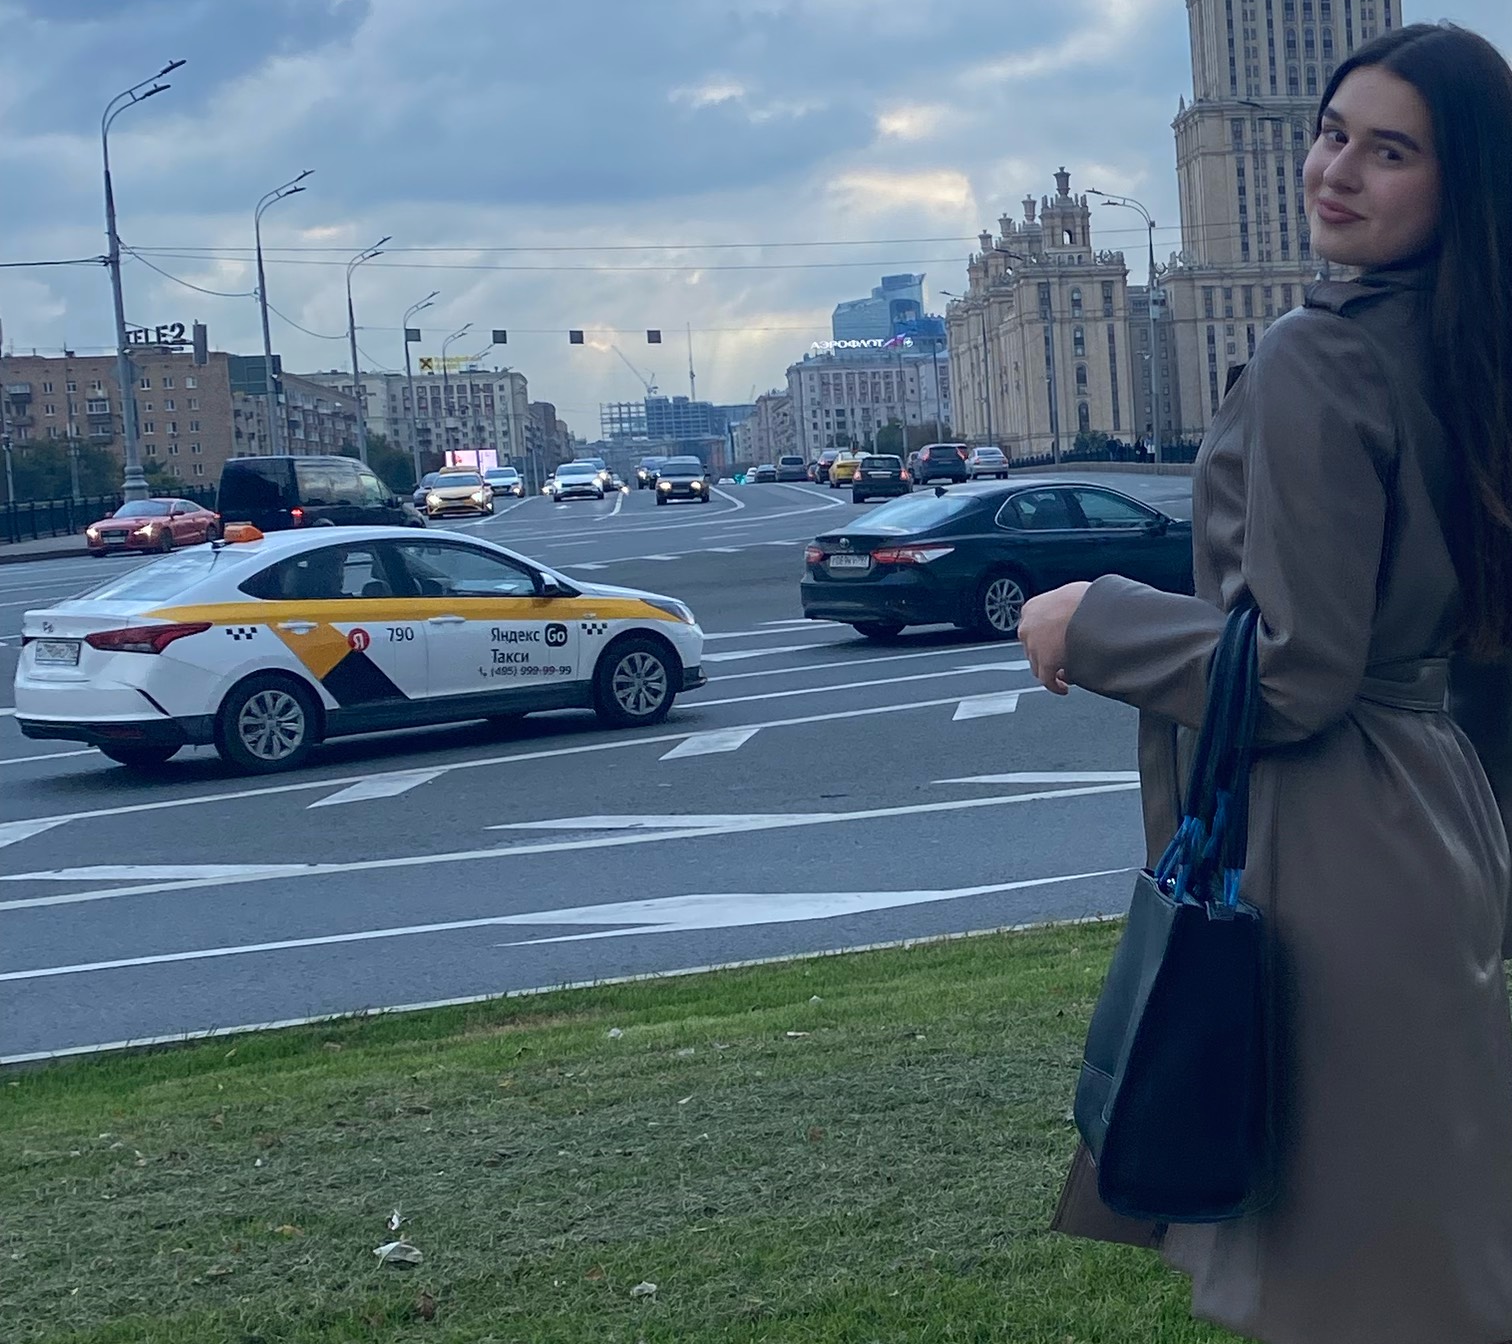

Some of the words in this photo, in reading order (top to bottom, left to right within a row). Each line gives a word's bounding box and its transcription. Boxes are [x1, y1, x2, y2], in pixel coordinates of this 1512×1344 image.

[124, 322, 185, 344] TELE2
[811, 339, 884, 349] АЭРОФЛОТ
[386, 627, 415, 642] 790
[491, 627, 540, 644] Яндекс
[546, 628, 567, 644] Go
[491, 649, 529, 664] Такси
[491, 667, 518, 677] (495)
